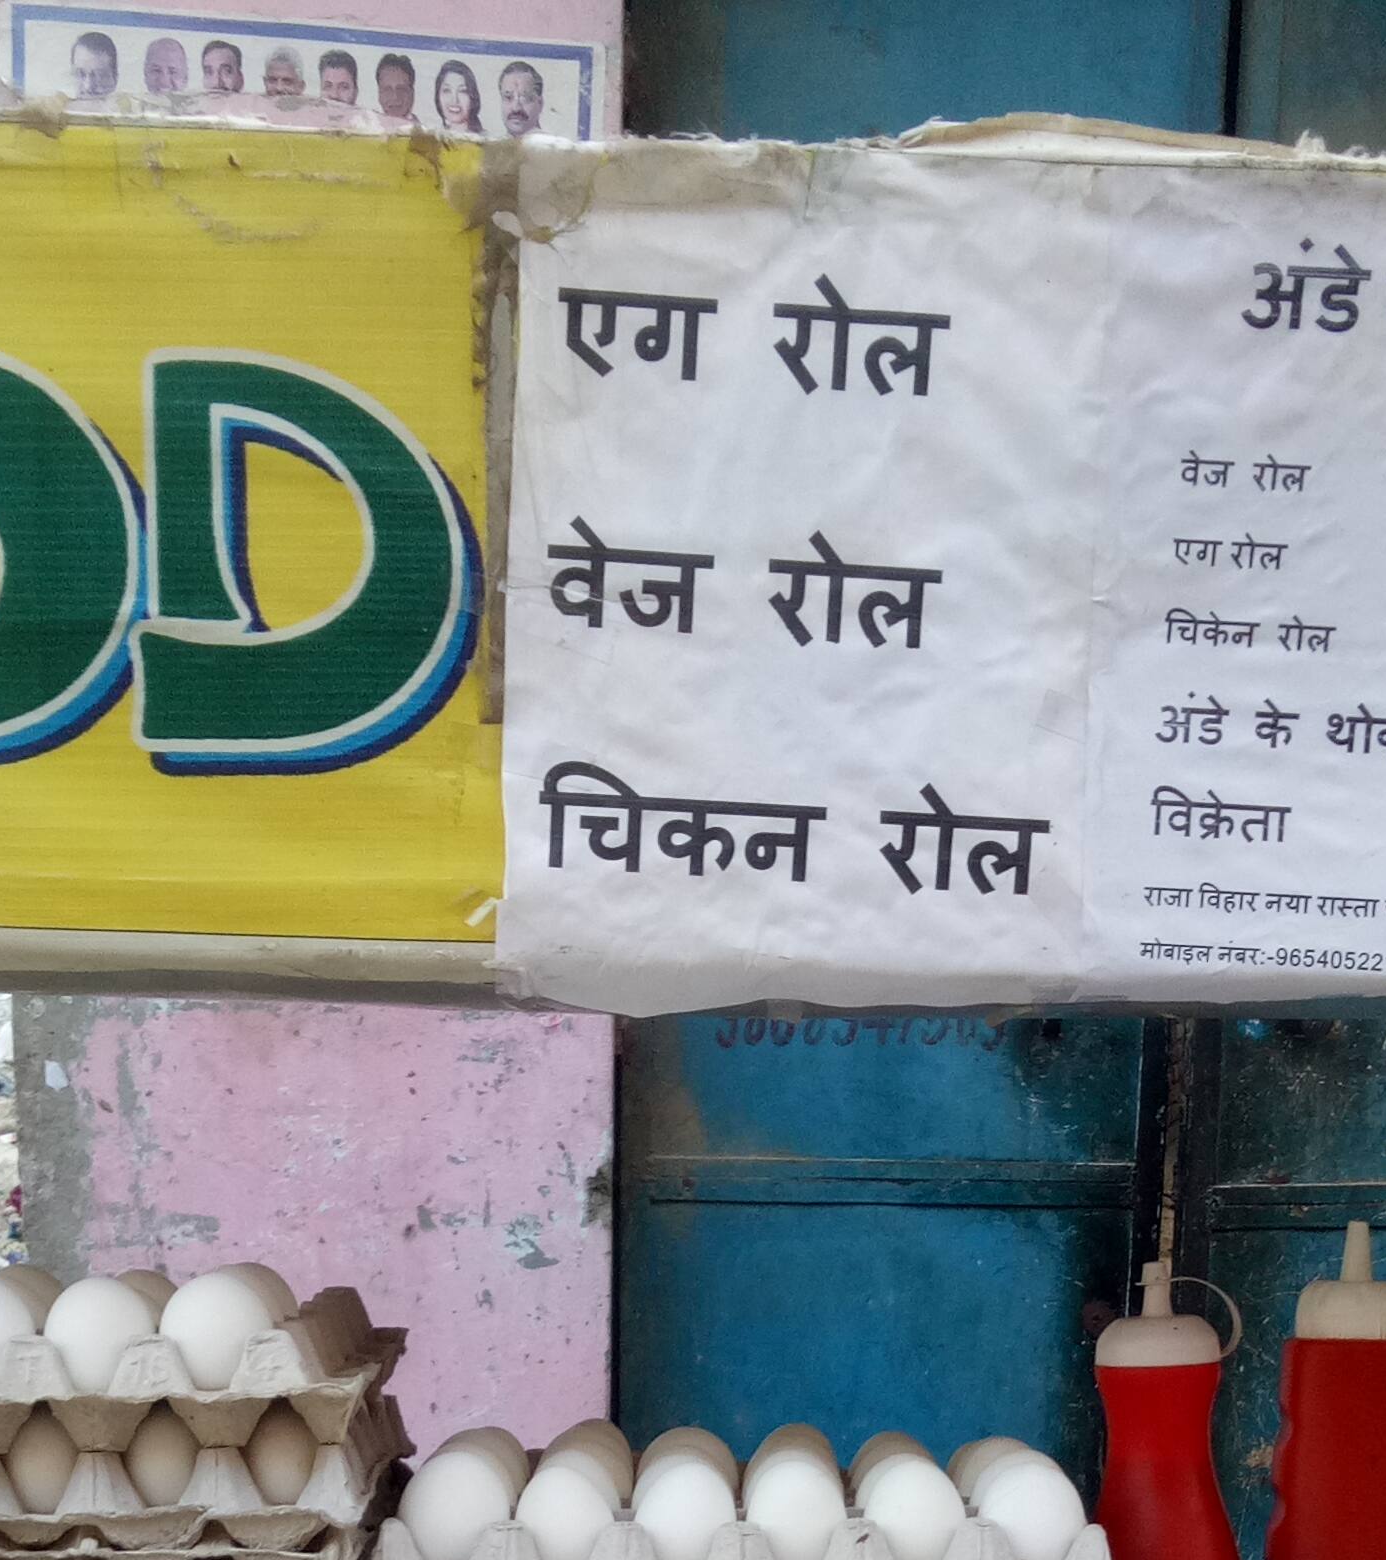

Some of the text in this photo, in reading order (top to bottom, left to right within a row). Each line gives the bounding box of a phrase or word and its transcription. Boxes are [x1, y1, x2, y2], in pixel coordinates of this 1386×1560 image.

[1241, 238, 1372, 333] अंडे
[558, 273, 951, 397] एग रोल
[1180, 450, 1312, 492] वेज रोल
[1173, 532, 1289, 570] एग रोल
[547, 515, 943, 649] वेज रोल
[1164, 607, 1337, 653] चिकेन रोल
[1155, 691, 1230, 746] अंडे
[1255, 698, 1300, 749] के
[539, 760, 1051, 896] चिकन रोल
[1150, 785, 1292, 843] विक्रेता
[1143, 886, 1194, 908] राजा
[1198, 882, 1261, 914] विहार
[1265, 893, 1313, 914] नया
[1317, 896, 1380, 918] रास्ता
[1140, 938, 1214, 965] मोबाइल
